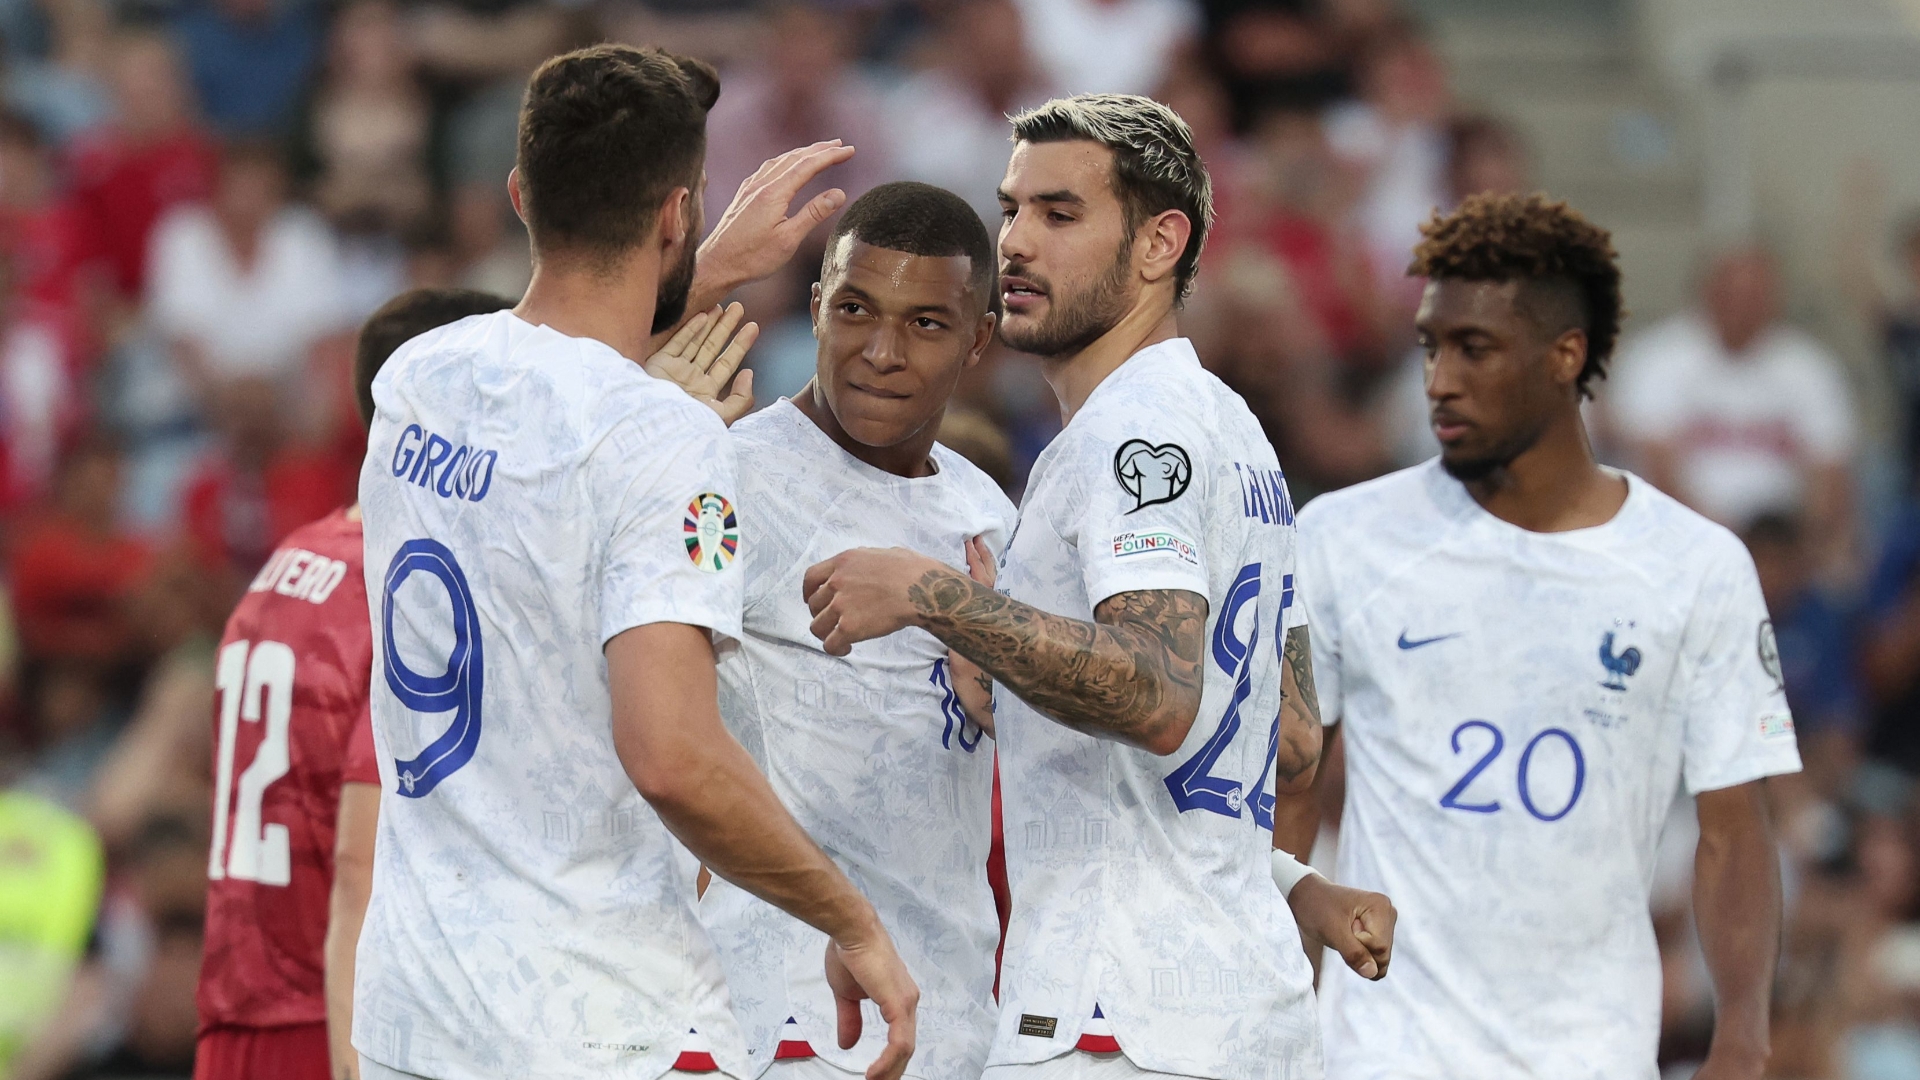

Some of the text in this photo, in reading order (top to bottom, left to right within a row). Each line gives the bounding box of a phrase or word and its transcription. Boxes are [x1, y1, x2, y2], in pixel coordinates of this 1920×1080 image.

[392, 423, 498, 502] GIROUD
[1113, 532, 1135, 543] UEFA
[1114, 536, 1197, 558] FOUNDATION
[382, 538, 484, 799] 9
[208, 638, 296, 887] 12
[1439, 719, 1586, 822] 20
